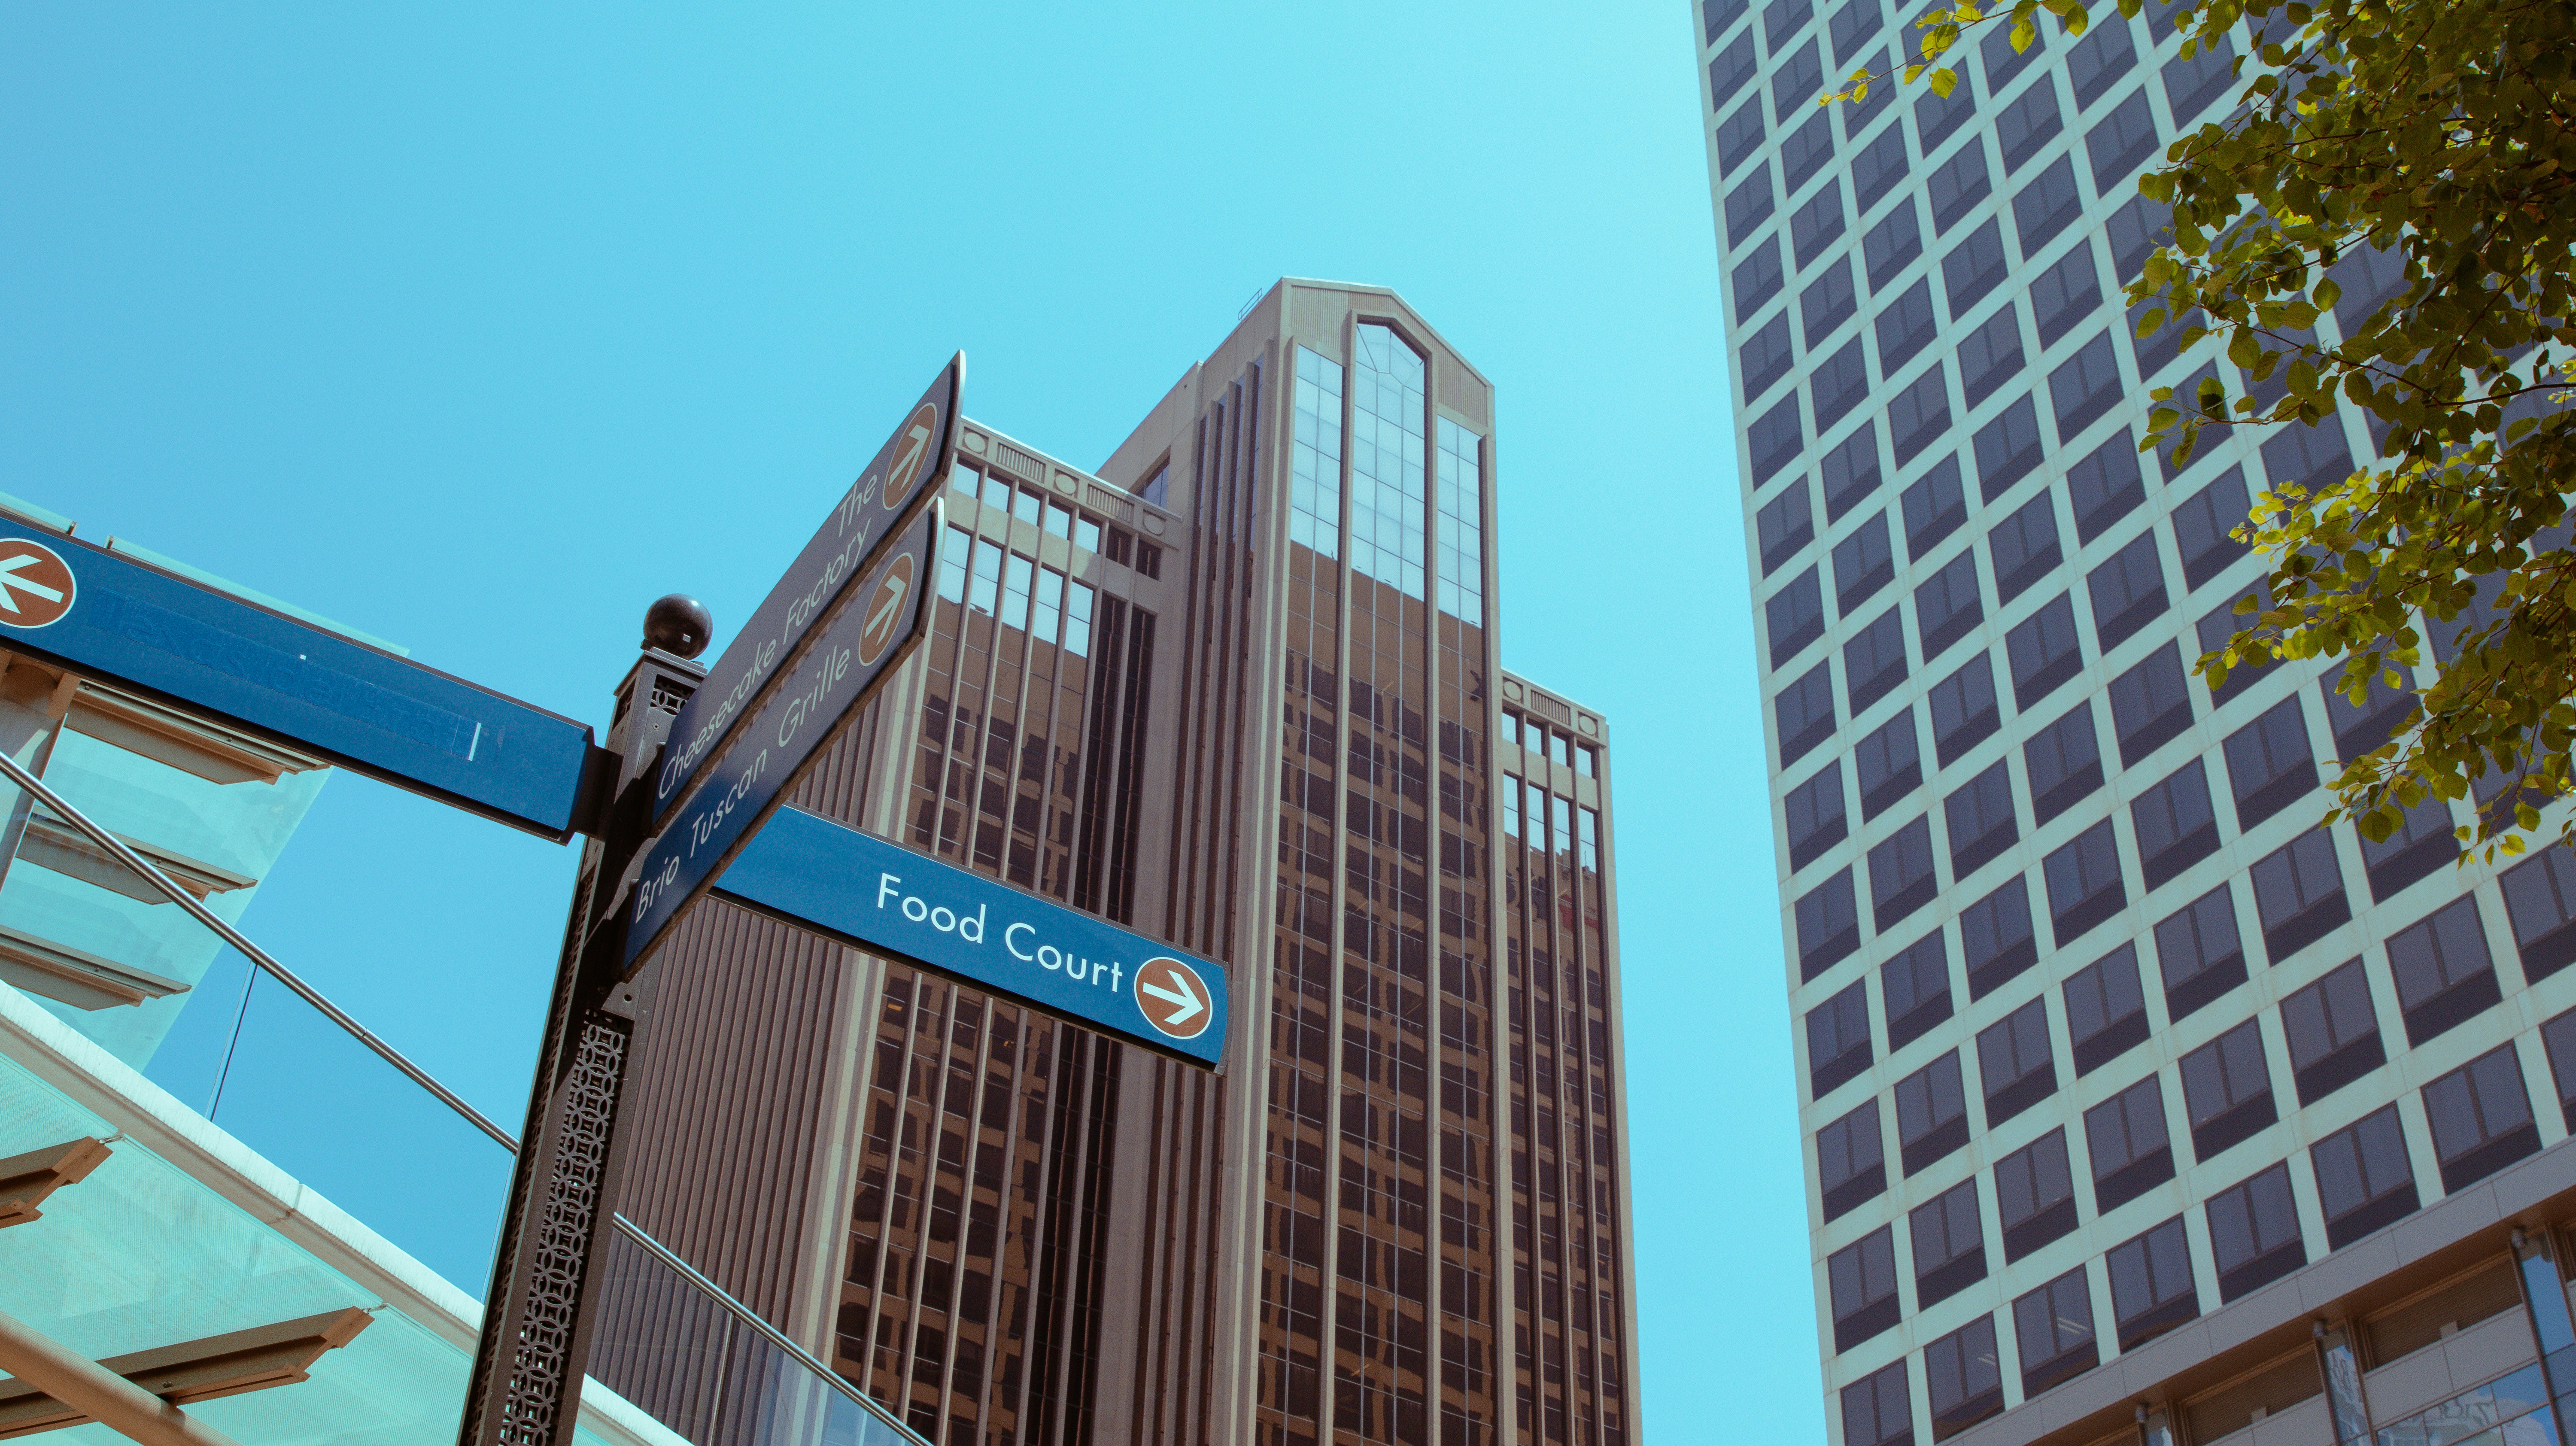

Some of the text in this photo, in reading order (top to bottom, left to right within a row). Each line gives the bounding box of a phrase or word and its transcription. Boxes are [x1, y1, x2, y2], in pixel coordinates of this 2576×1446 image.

[838, 474, 877, 537] The
[659, 517, 871, 799] Cheesecake Factory
[635, 645, 850, 923] Brio Tuscan Grille
[878, 872, 1123, 992] Food Court
